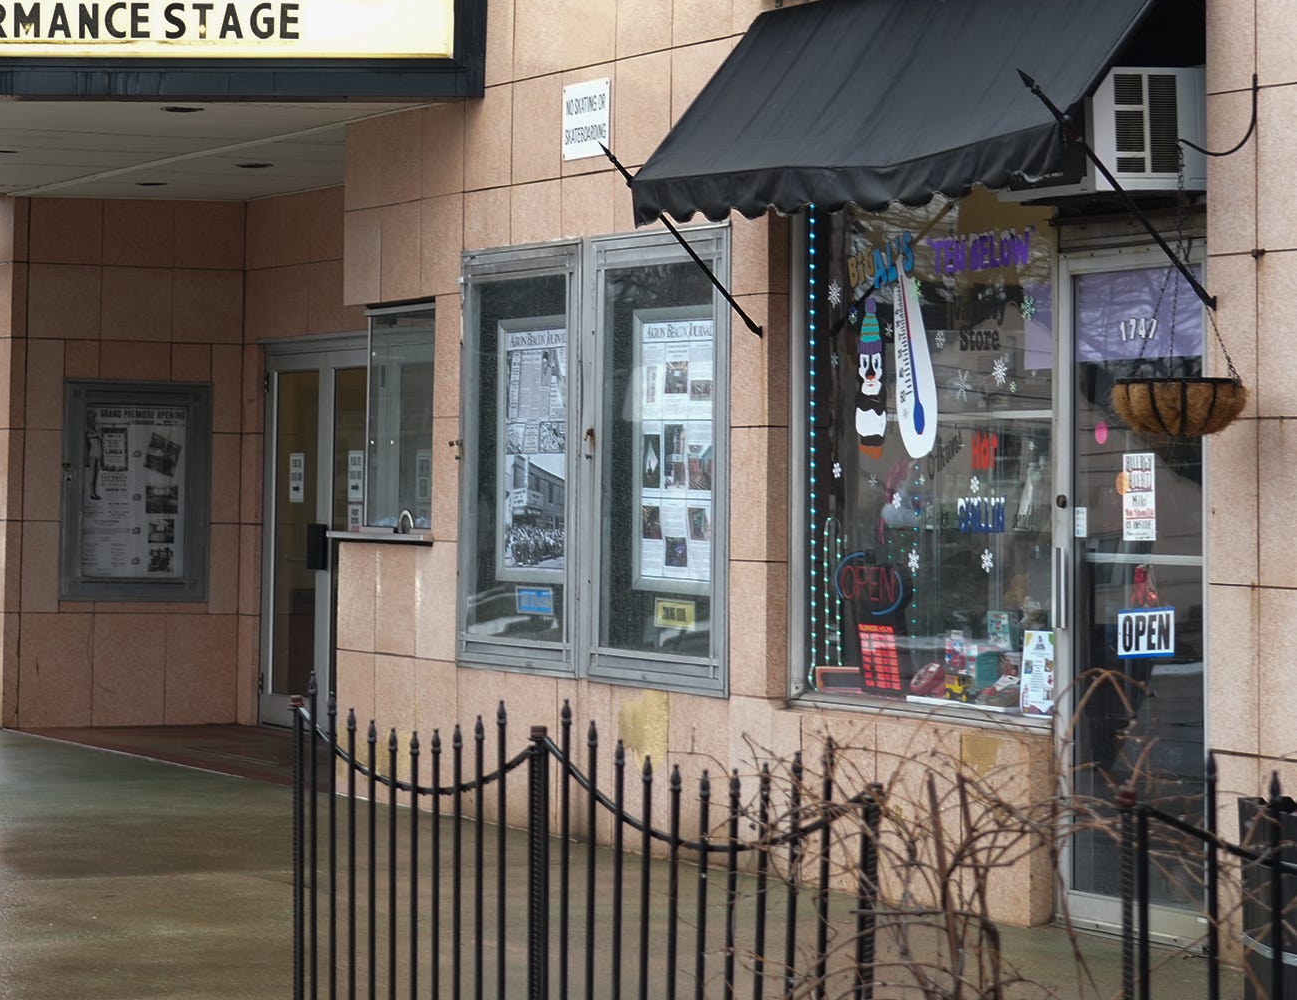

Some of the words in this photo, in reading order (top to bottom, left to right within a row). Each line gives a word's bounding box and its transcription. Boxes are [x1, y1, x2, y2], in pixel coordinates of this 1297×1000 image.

[164, 3, 301, 40] STAGE
[959, 326, 1001, 352] Store
[840, 564, 896, 603] OPEN
[1122, 613, 1171, 653] OPEN
